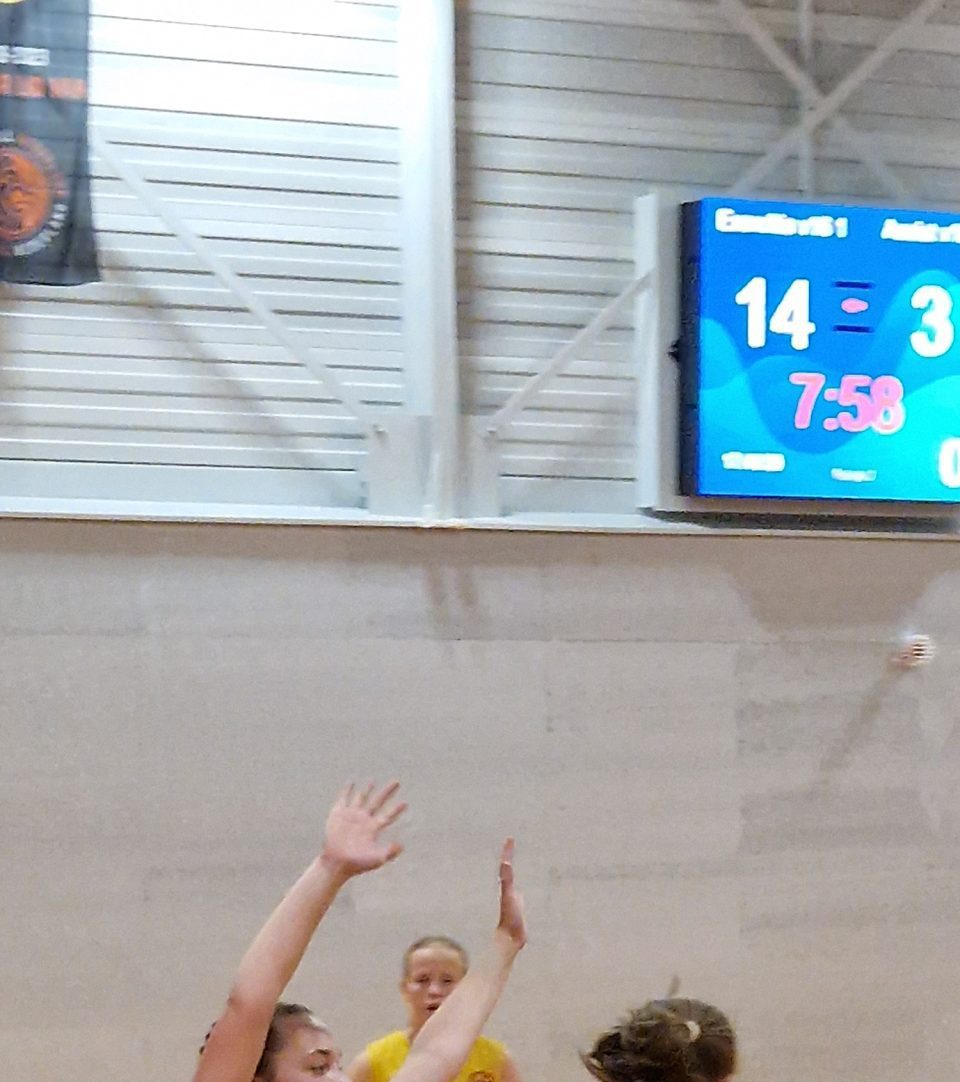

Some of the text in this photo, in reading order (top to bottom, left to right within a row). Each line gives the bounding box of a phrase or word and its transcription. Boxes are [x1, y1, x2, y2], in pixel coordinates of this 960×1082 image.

[735, 277, 954, 357] 14 3
[789, 372, 905, 434] 7:58
